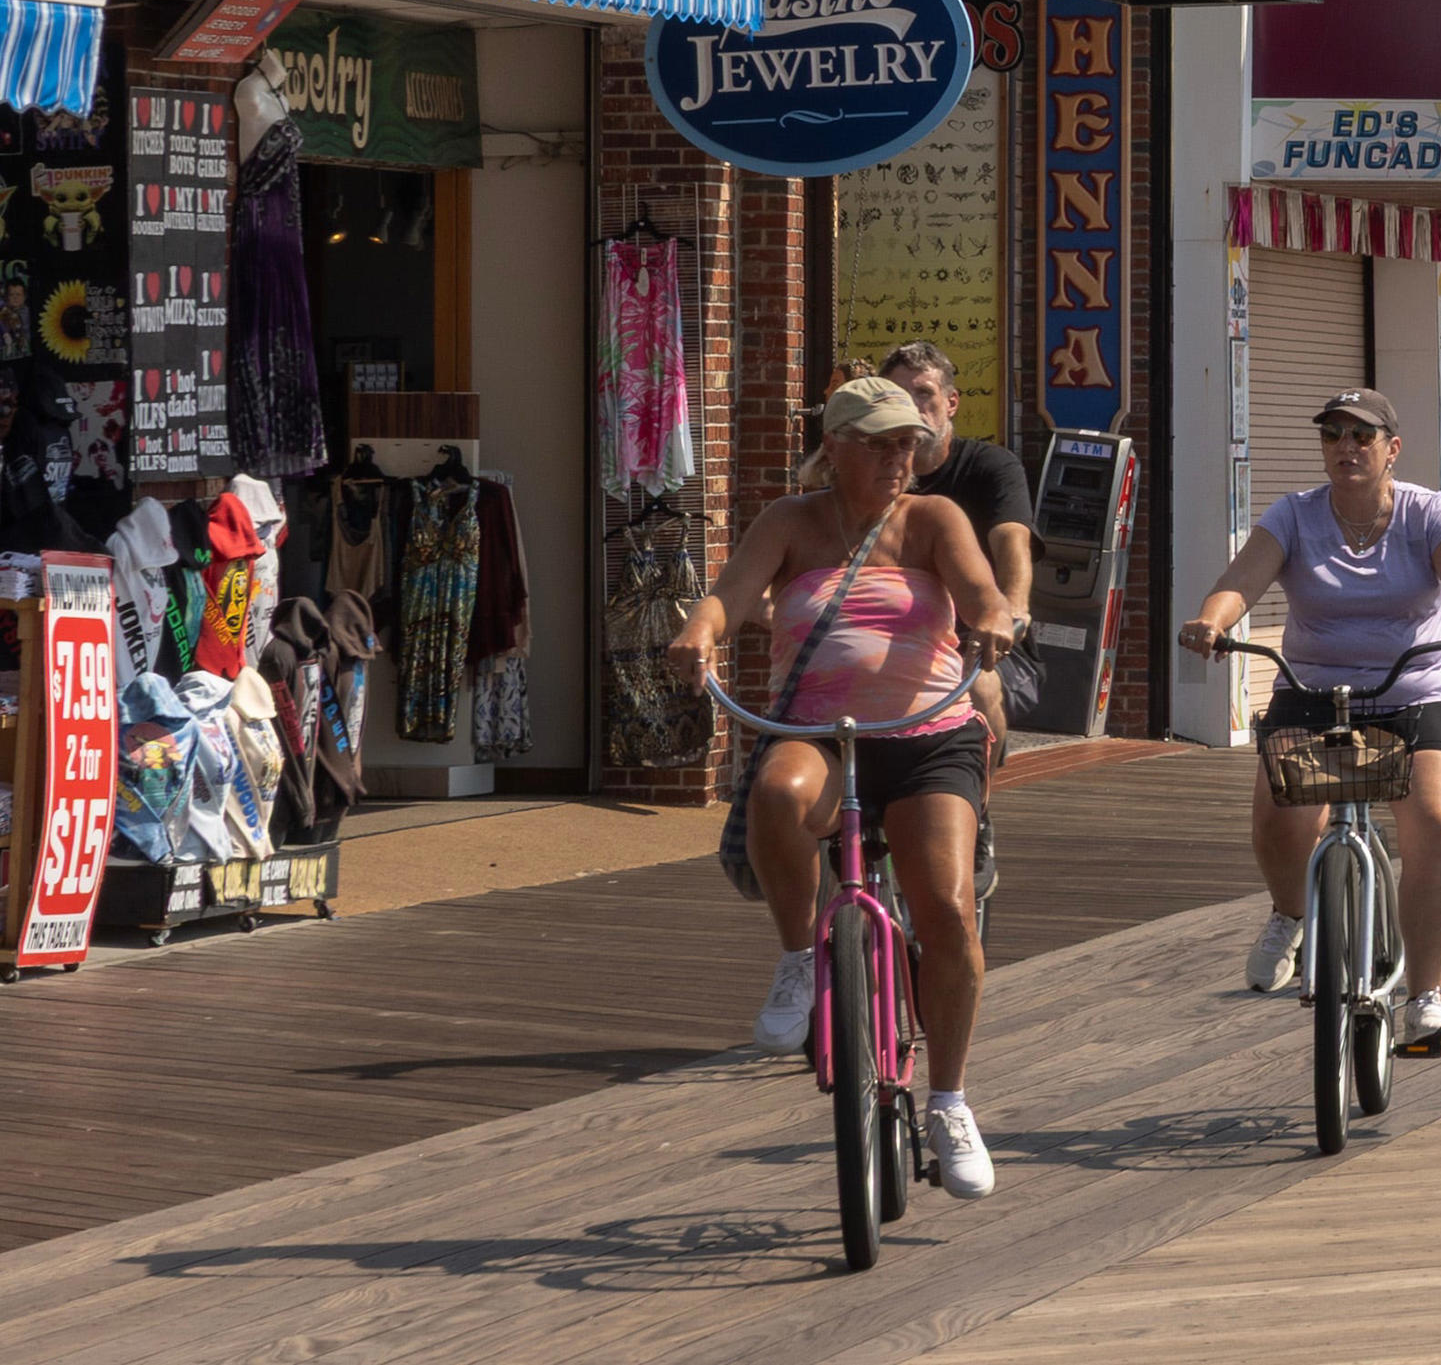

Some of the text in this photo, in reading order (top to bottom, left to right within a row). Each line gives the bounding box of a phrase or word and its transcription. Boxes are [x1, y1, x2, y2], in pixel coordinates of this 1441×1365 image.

[219, 4, 261, 17] HOODIES
[680, 35, 945, 113] JEWELRY
[1332, 109, 1419, 138] ED'S
[169, 134, 197, 153] TOXIC
[199, 138, 226, 156] TOXIC
[54, 168, 112, 182] DUNKIN'
[169, 154, 195, 175] BOYS
[198, 158, 227, 178] GIRLS
[175, 187, 195, 212] MY
[208, 189, 228, 214] MY
[1049, 15, 1116, 389] HENNA
[164, 298, 196, 325] MILFS
[197, 307, 227, 327] SLUTS
[177, 369, 196, 393] hot
[167, 394, 197, 417] dads
[179, 427, 197, 452] hot
[199, 440, 230, 456] WOMEN
[1070, 443, 1104, 456] ATM
[167, 453, 198, 473] moms
[53, 641, 111, 721] $7.99
[65, 734, 102, 782] 2 for
[43, 797, 108, 897] $15
[25, 920, 87, 951] THIS TABLE ONLY
